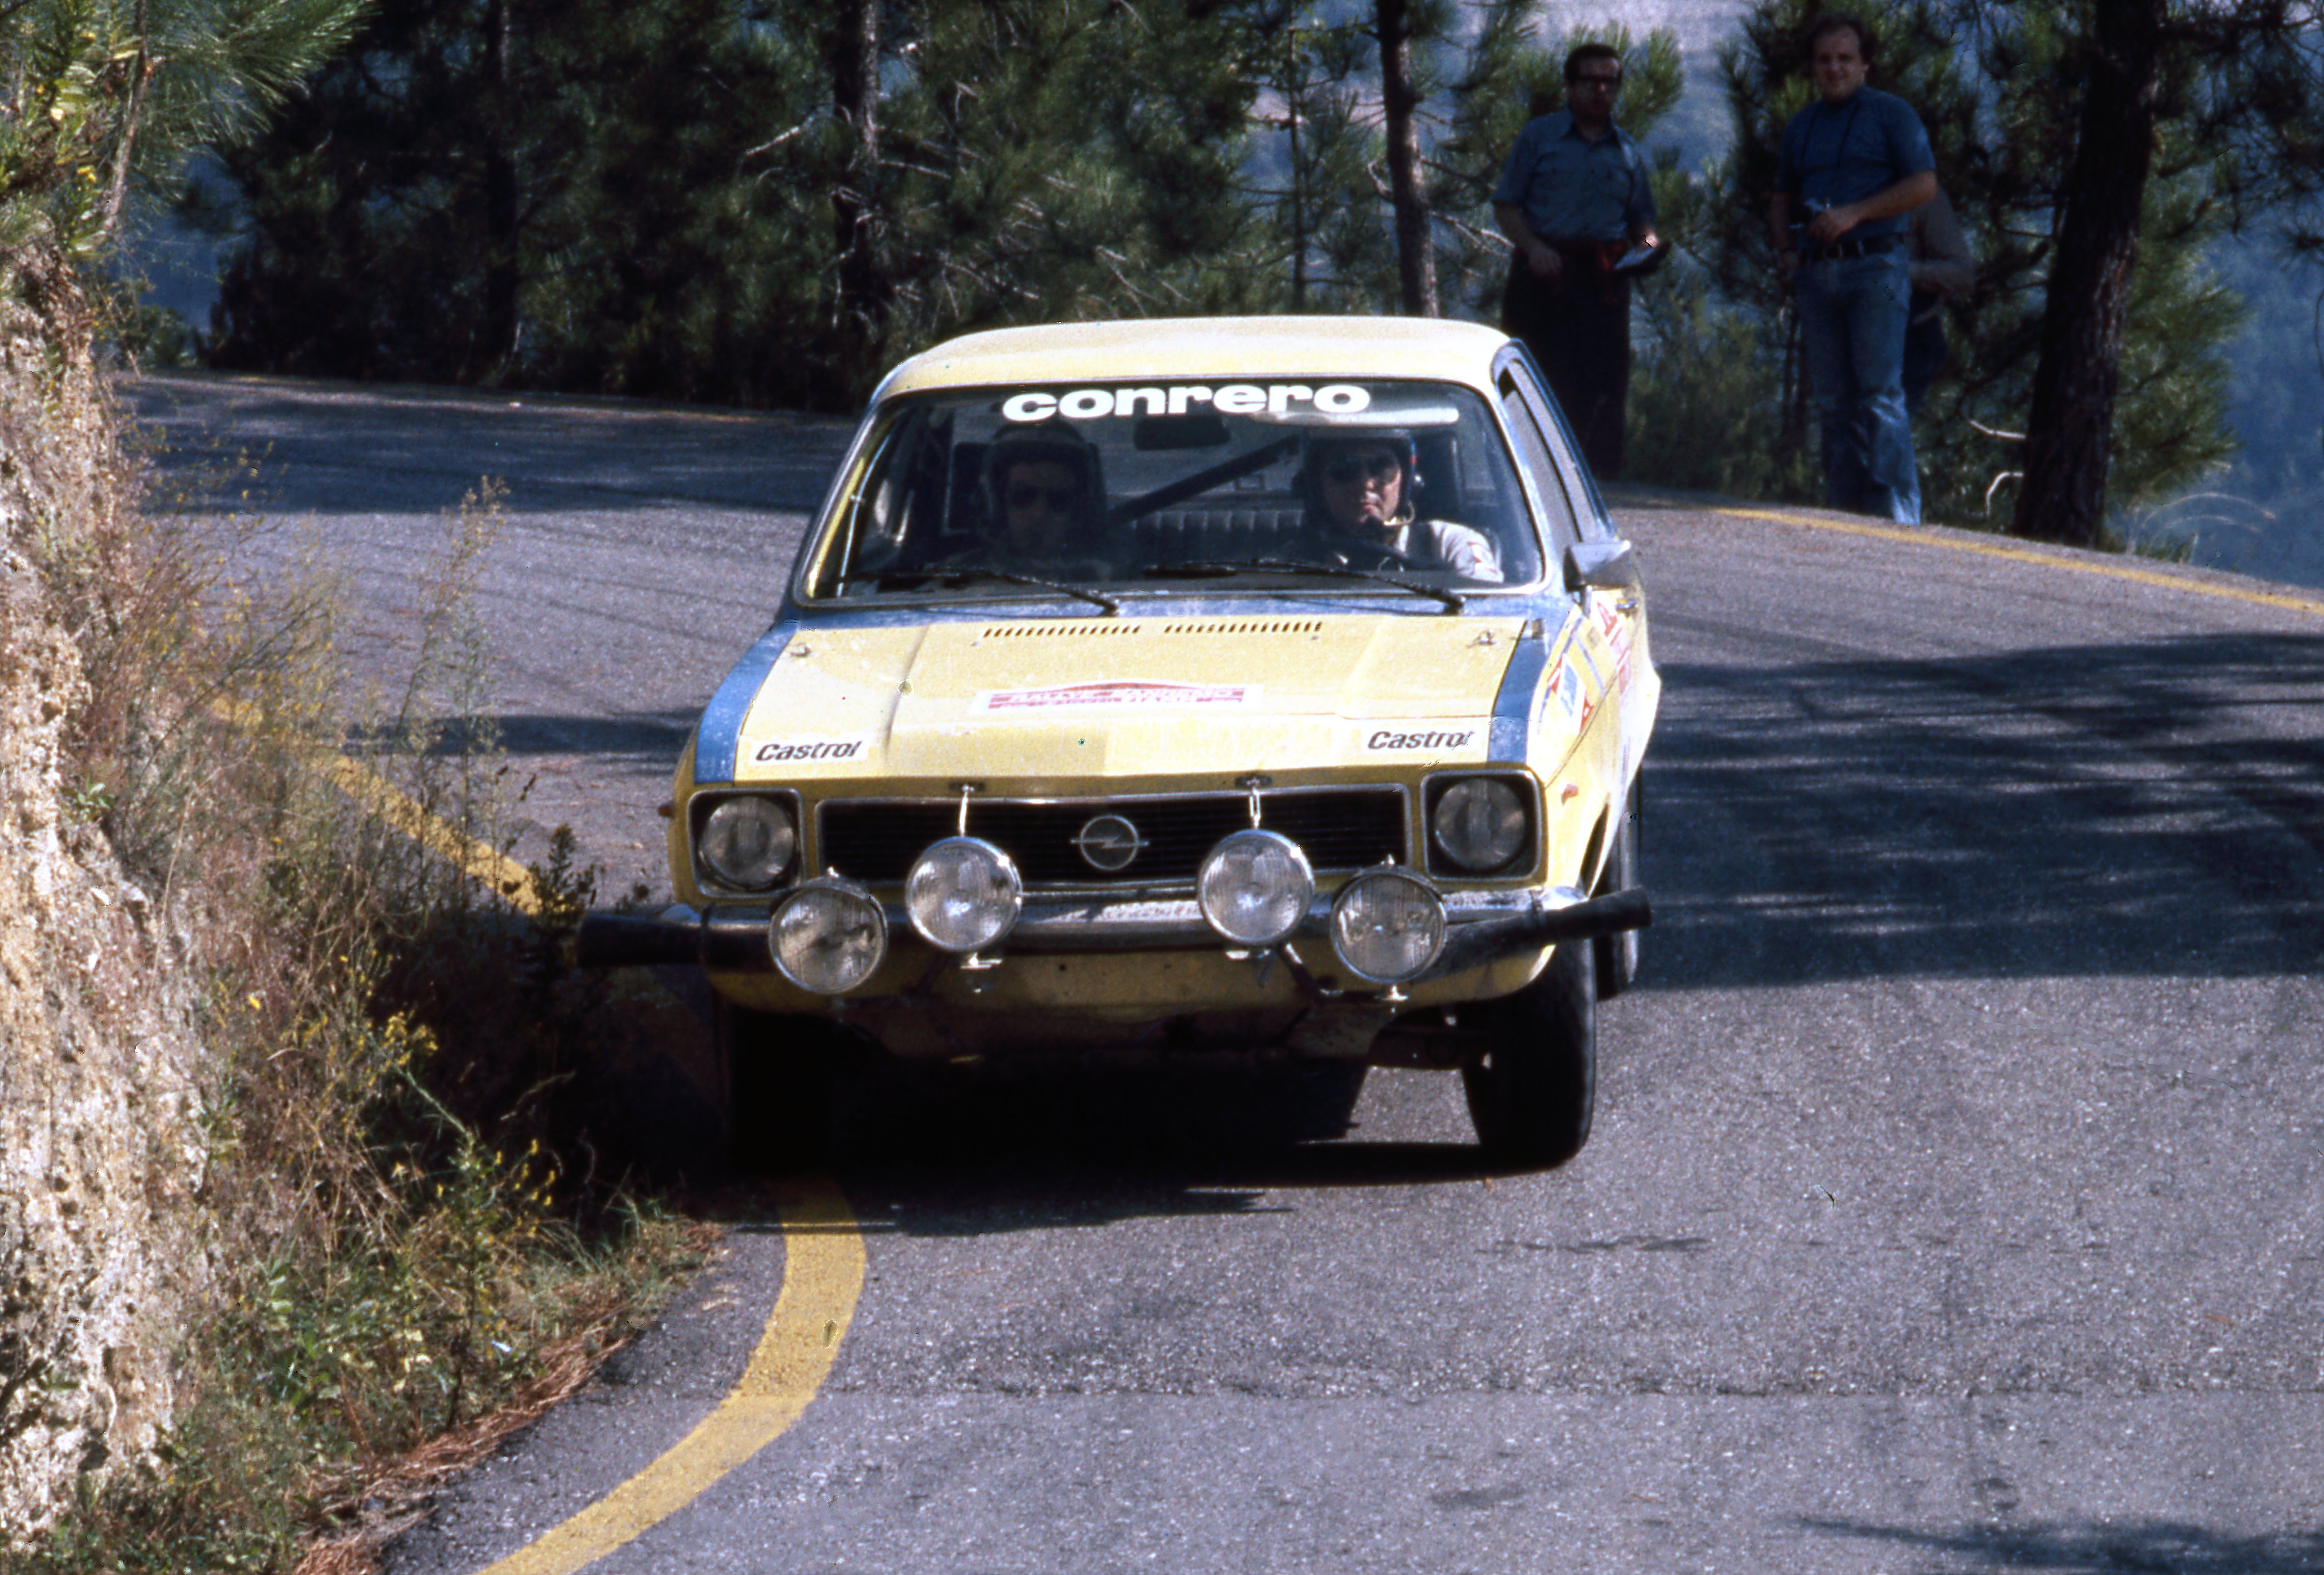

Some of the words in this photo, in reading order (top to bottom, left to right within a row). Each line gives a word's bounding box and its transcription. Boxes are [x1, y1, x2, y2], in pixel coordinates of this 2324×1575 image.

[1003, 384, 1370, 422] conrero
[1368, 731, 1475, 749] Castrol
[755, 741, 862, 761] Castrol
